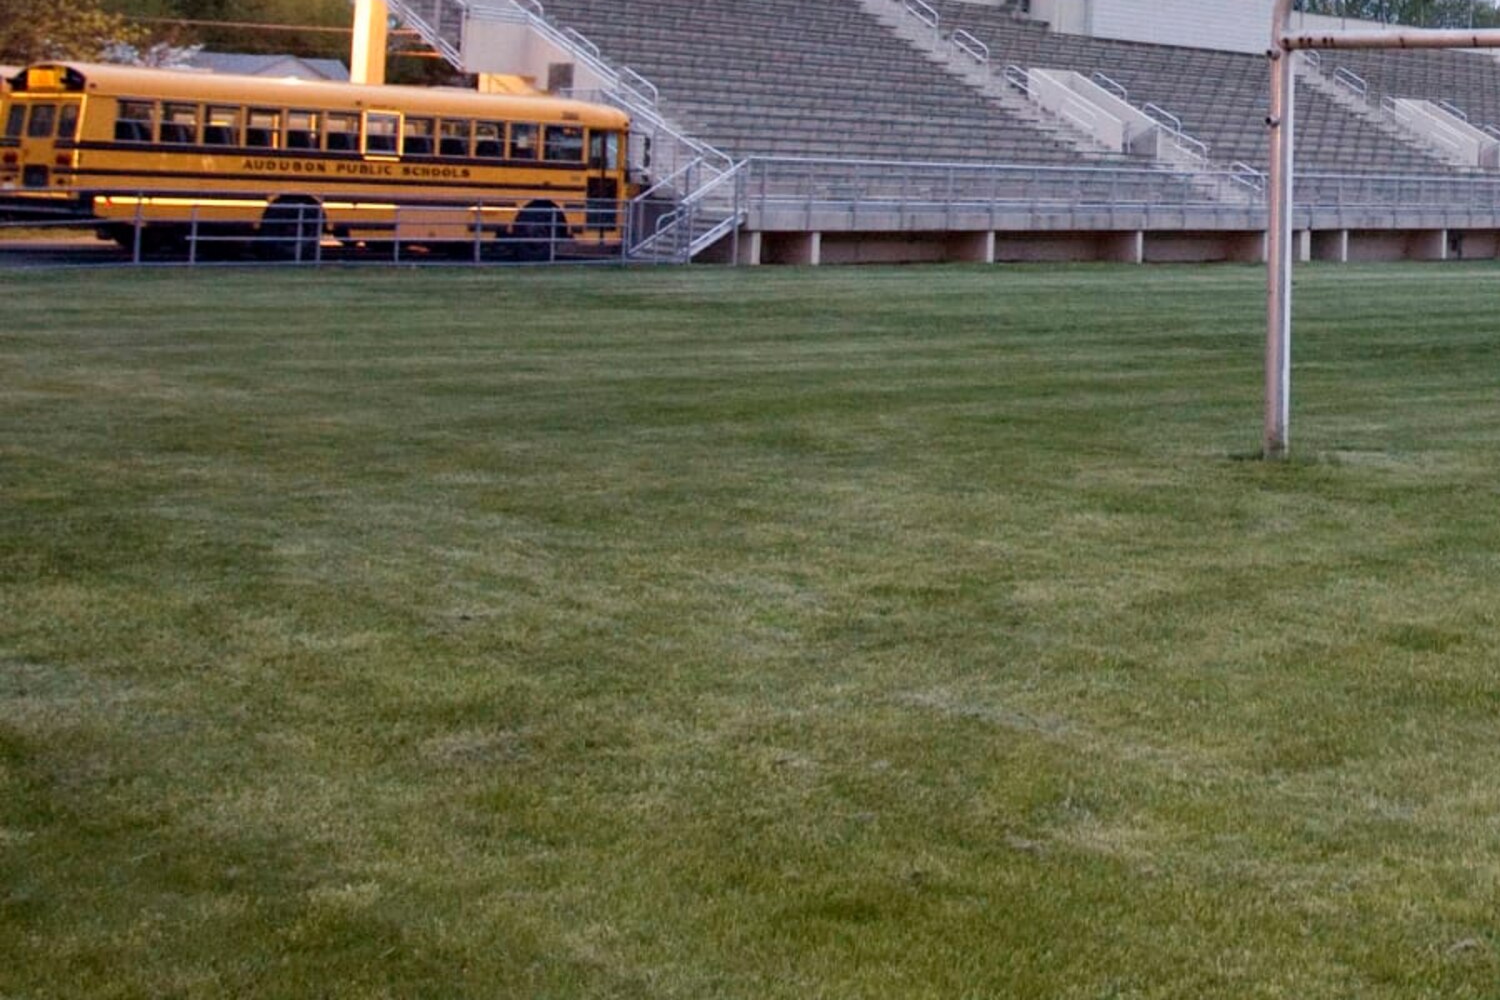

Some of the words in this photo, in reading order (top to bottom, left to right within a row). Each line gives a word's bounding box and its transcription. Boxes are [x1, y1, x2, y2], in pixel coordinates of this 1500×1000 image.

[243, 159, 326, 172] AUDUBON
[336, 162, 393, 175] PUBLIC
[402, 165, 471, 178] SCHOOLS
